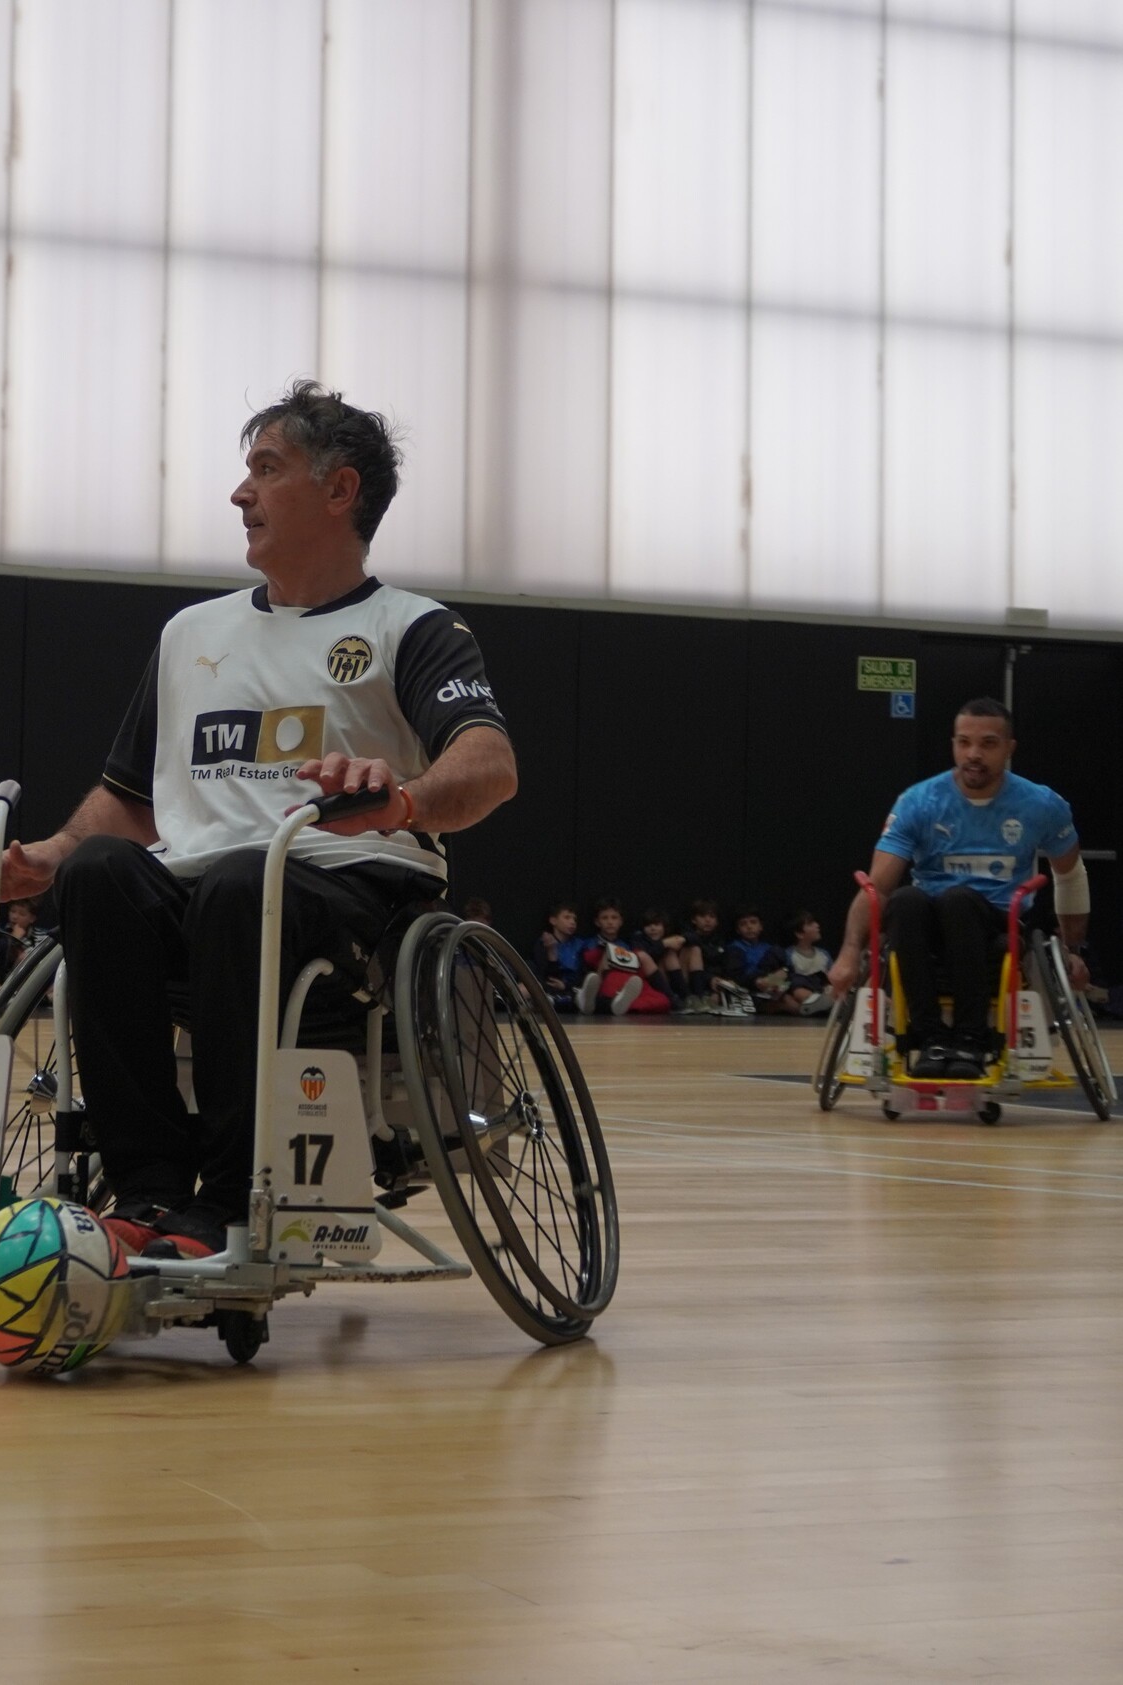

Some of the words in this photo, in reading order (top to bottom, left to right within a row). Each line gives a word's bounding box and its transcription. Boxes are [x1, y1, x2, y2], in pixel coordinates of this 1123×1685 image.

[202, 723, 246, 753] TM
[191, 769, 211, 780] TM
[215, 765, 234, 779] Real
[239, 767, 279, 779] Estate
[289, 1134, 334, 1185] 17
